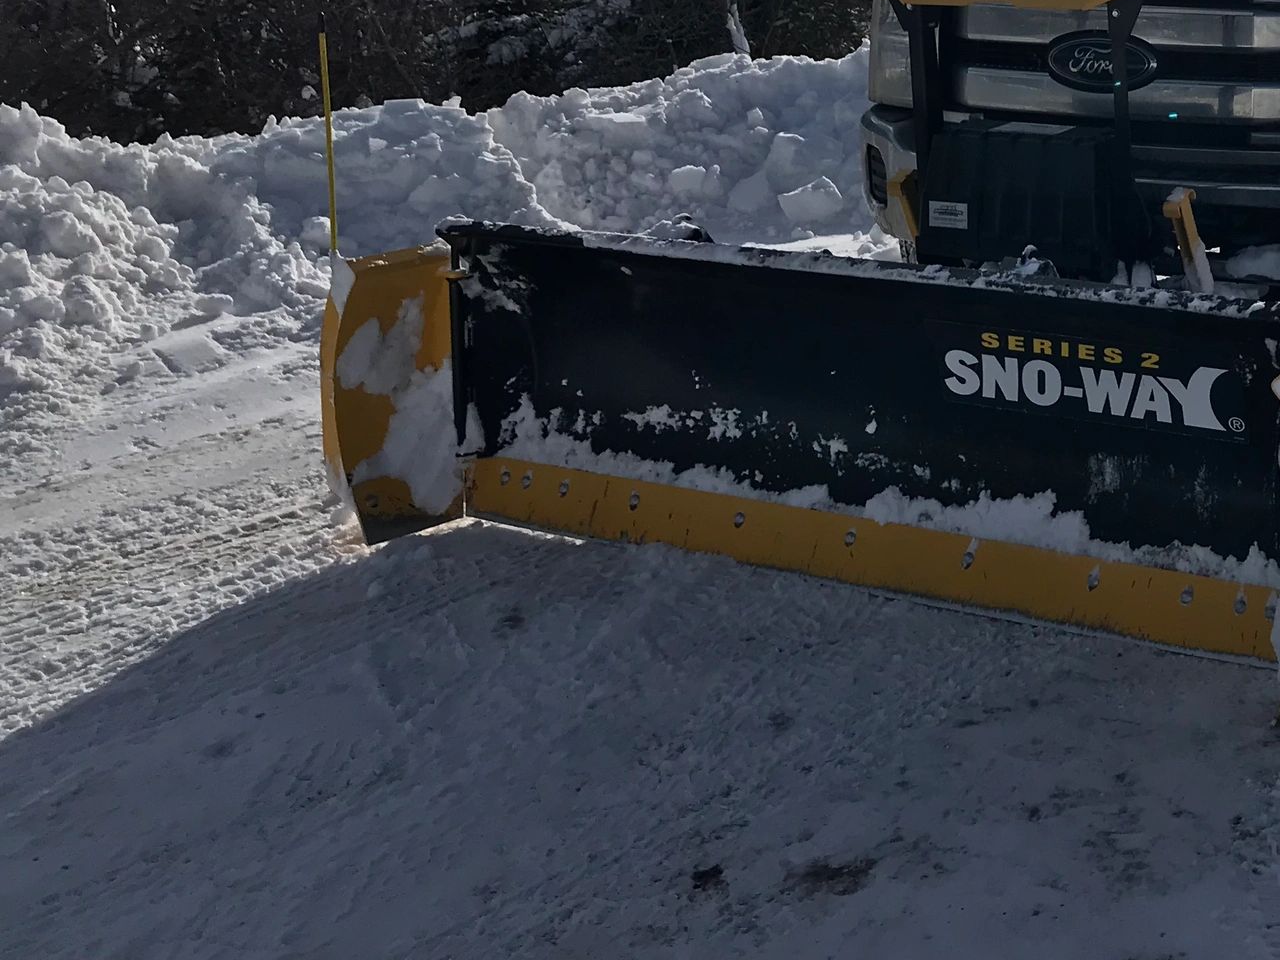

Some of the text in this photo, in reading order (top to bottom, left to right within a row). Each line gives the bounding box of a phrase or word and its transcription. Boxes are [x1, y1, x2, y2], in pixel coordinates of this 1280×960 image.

[1068, 45, 1113, 74] For
[980, 331, 1160, 369] SERIES 2
[944, 349, 1230, 432] SNO-WAY
